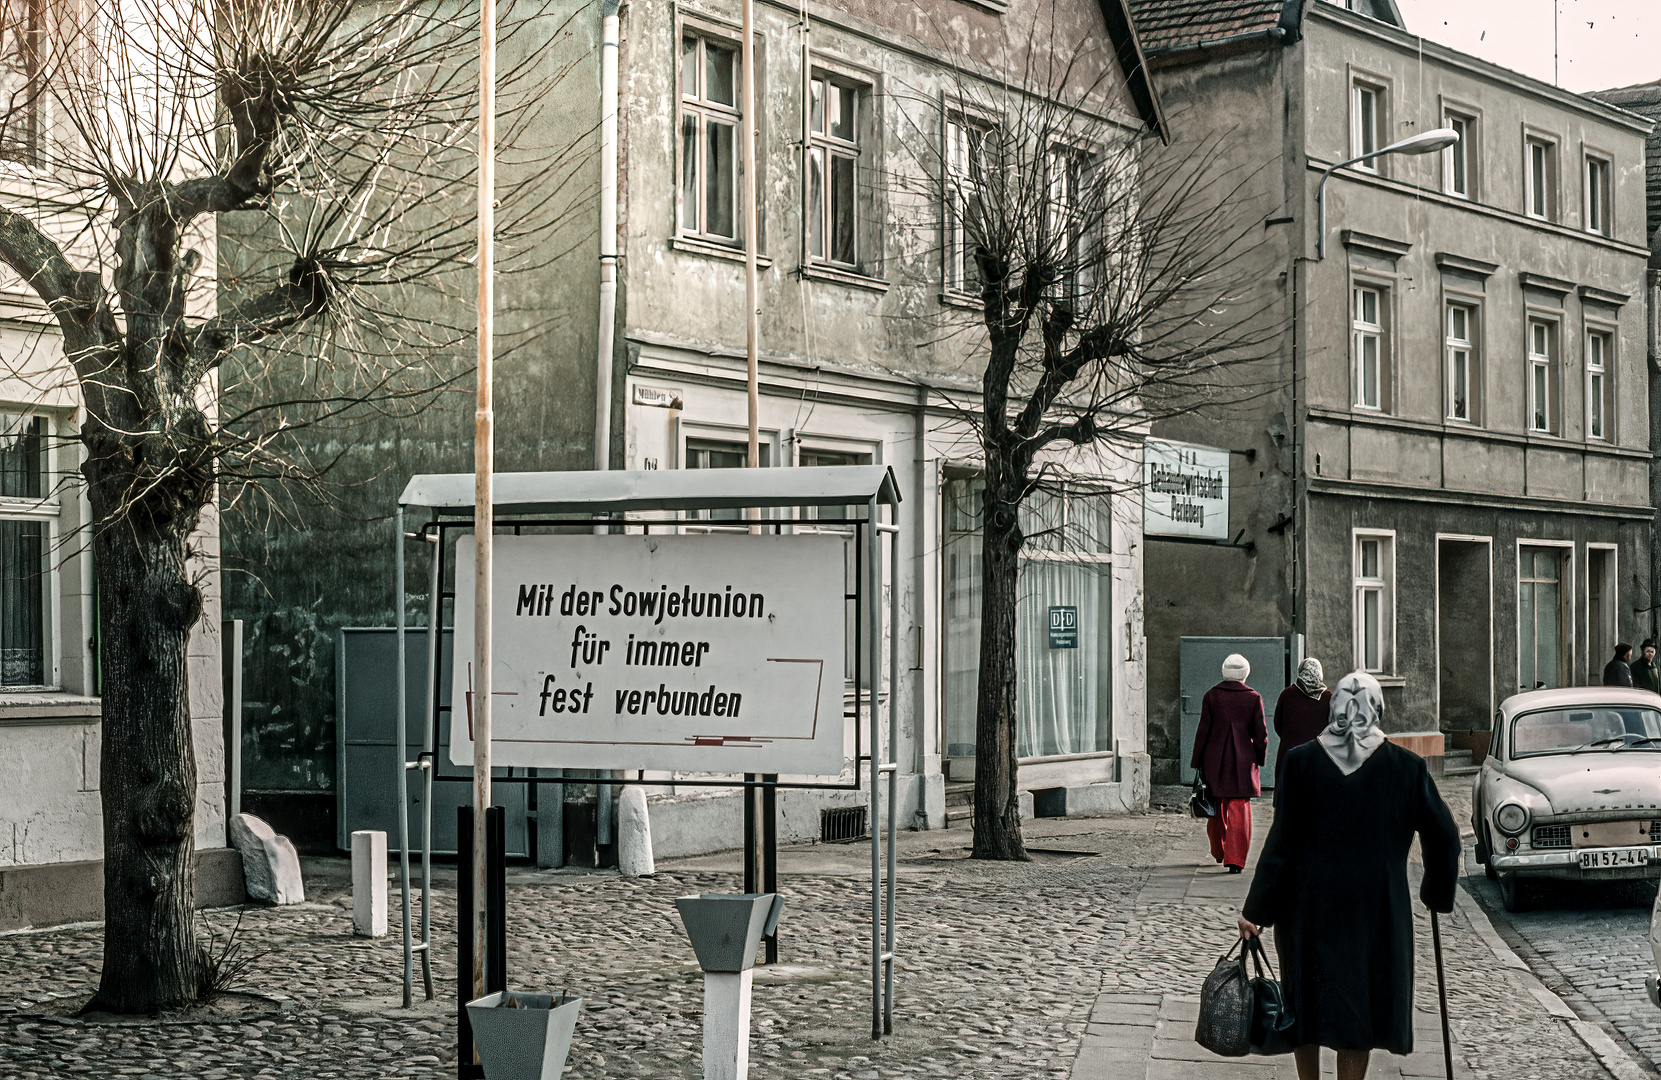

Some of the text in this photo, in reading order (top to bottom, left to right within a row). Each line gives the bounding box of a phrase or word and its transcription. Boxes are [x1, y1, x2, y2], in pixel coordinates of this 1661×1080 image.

[516, 583, 764, 626] Mit der Sowjetunion
[570, 625, 710, 668] für immer
[538, 674, 742, 718] fest verbunden
[1583, 851, 1644, 867] BH 52-44
